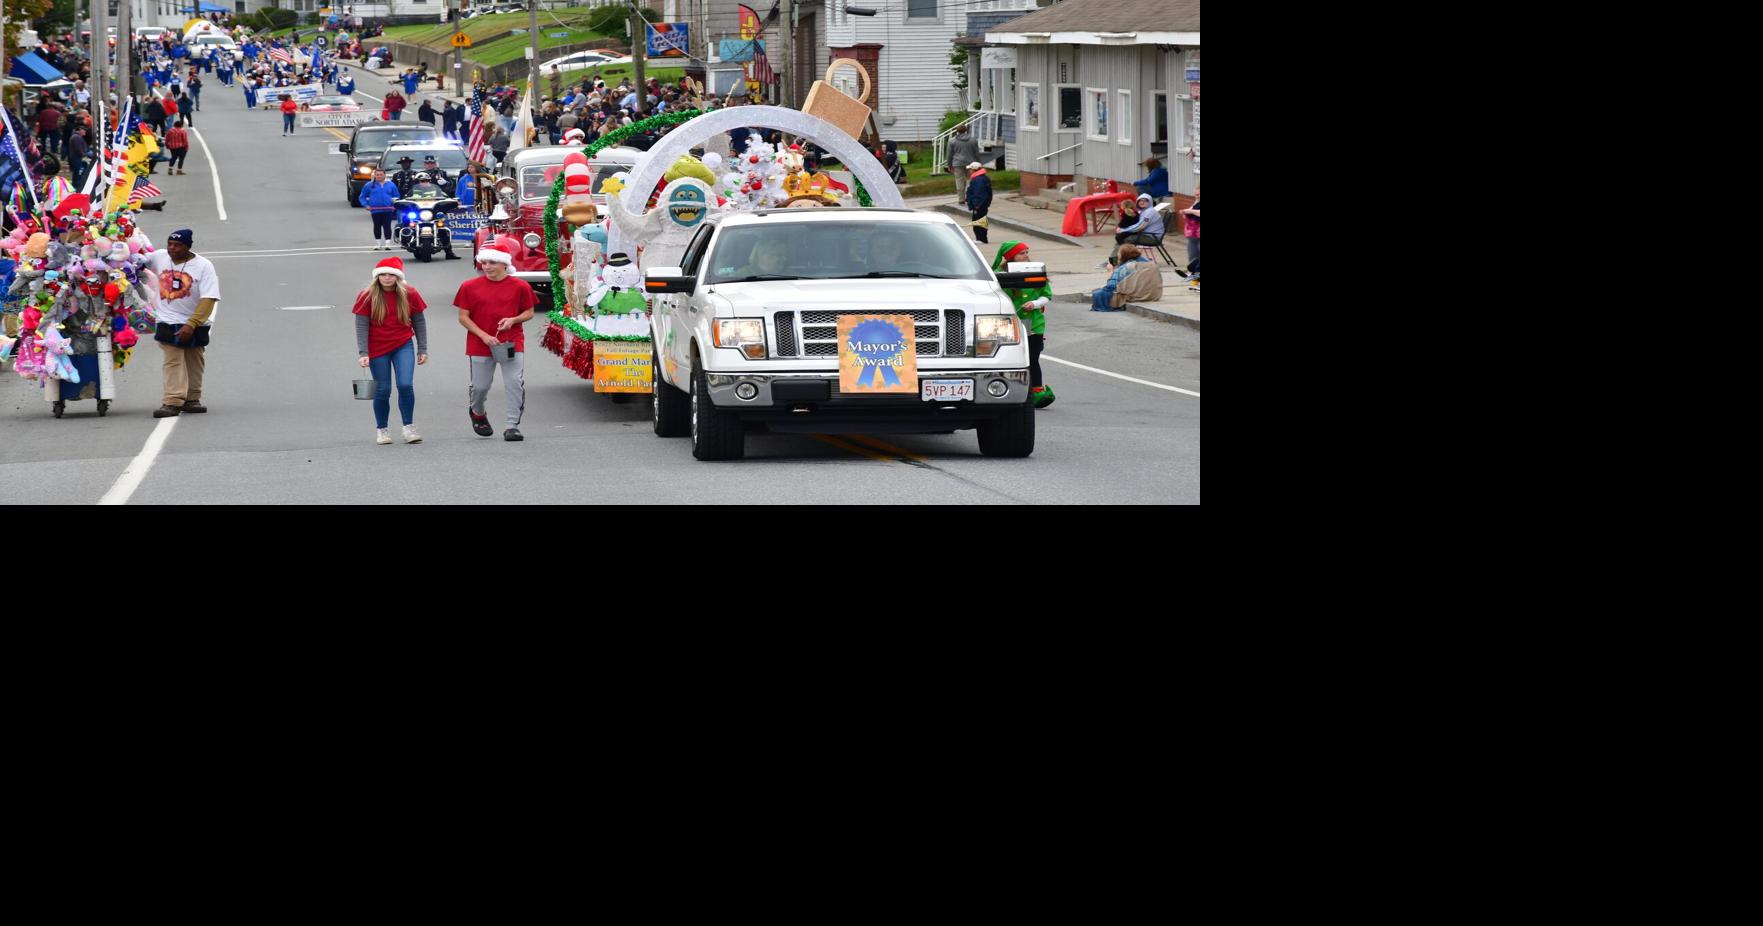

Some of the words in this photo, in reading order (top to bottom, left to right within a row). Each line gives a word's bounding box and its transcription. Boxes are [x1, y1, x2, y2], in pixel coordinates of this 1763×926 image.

[847, 340, 908, 355] Mayor's
[597, 357, 628, 366] Grand
[852, 355, 905, 367] Award
[625, 367, 644, 377] The
[598, 378, 634, 388] Arnold
[925, 385, 947, 396] 5VP
[950, 385, 971, 396] 147
